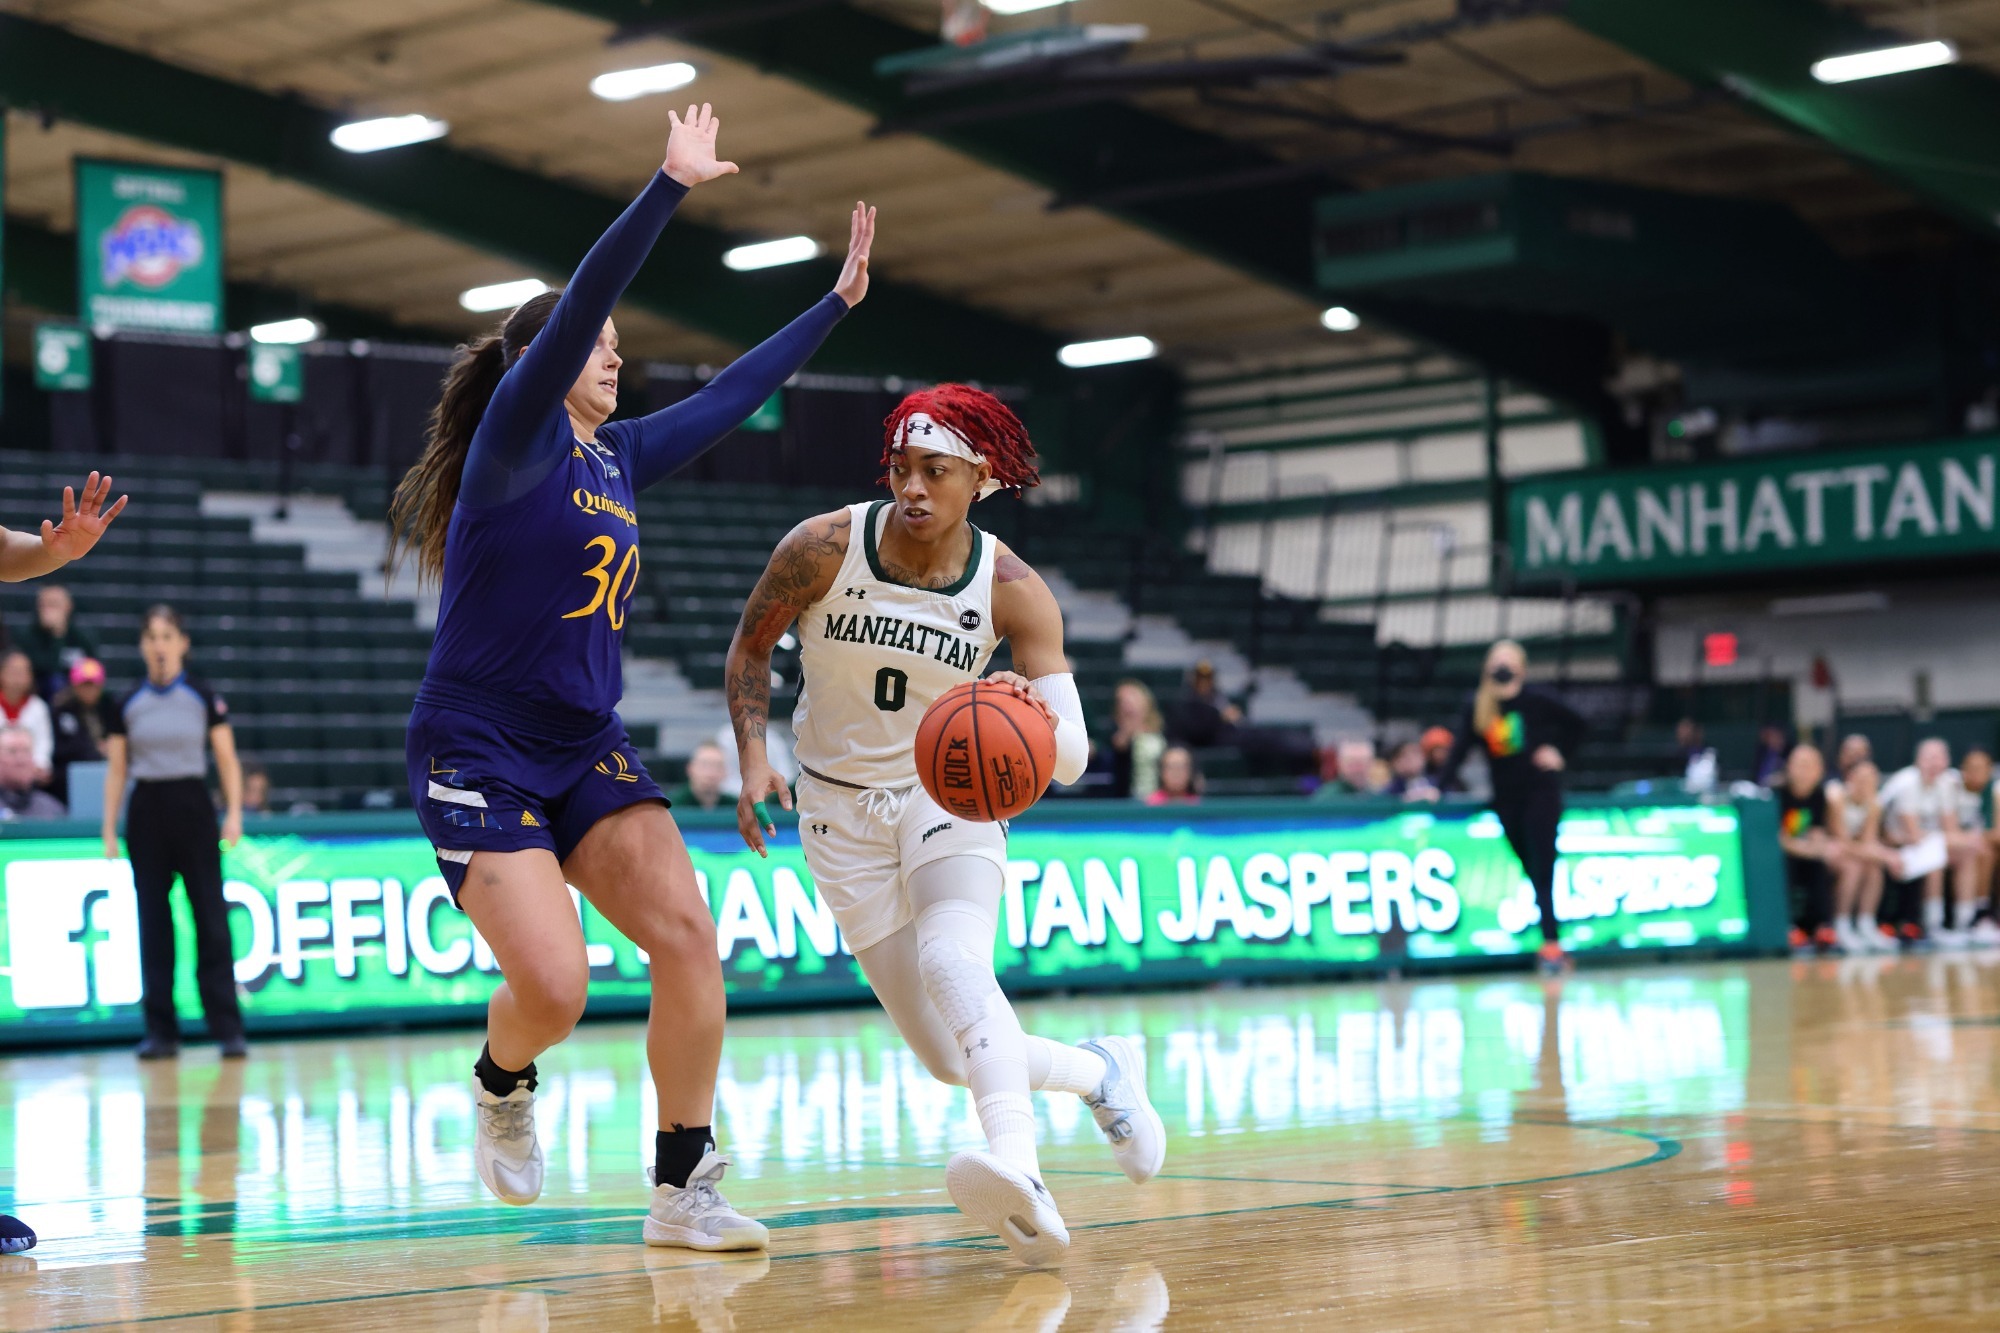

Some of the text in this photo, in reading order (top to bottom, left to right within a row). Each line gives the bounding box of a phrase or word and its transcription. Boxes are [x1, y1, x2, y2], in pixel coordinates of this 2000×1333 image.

[1525, 456, 1996, 566] MANHATTAN
[561, 536, 640, 630] 30
[824, 614, 979, 672] MANHATTAN
[962, 615, 979, 625] BLM
[874, 667, 908, 712] 0
[944, 736, 973, 790] ROCK
[922, 822, 952, 844] MAAC
[223, 876, 614, 981] OFFIC
[1157, 848, 1461, 942] JASPERS
